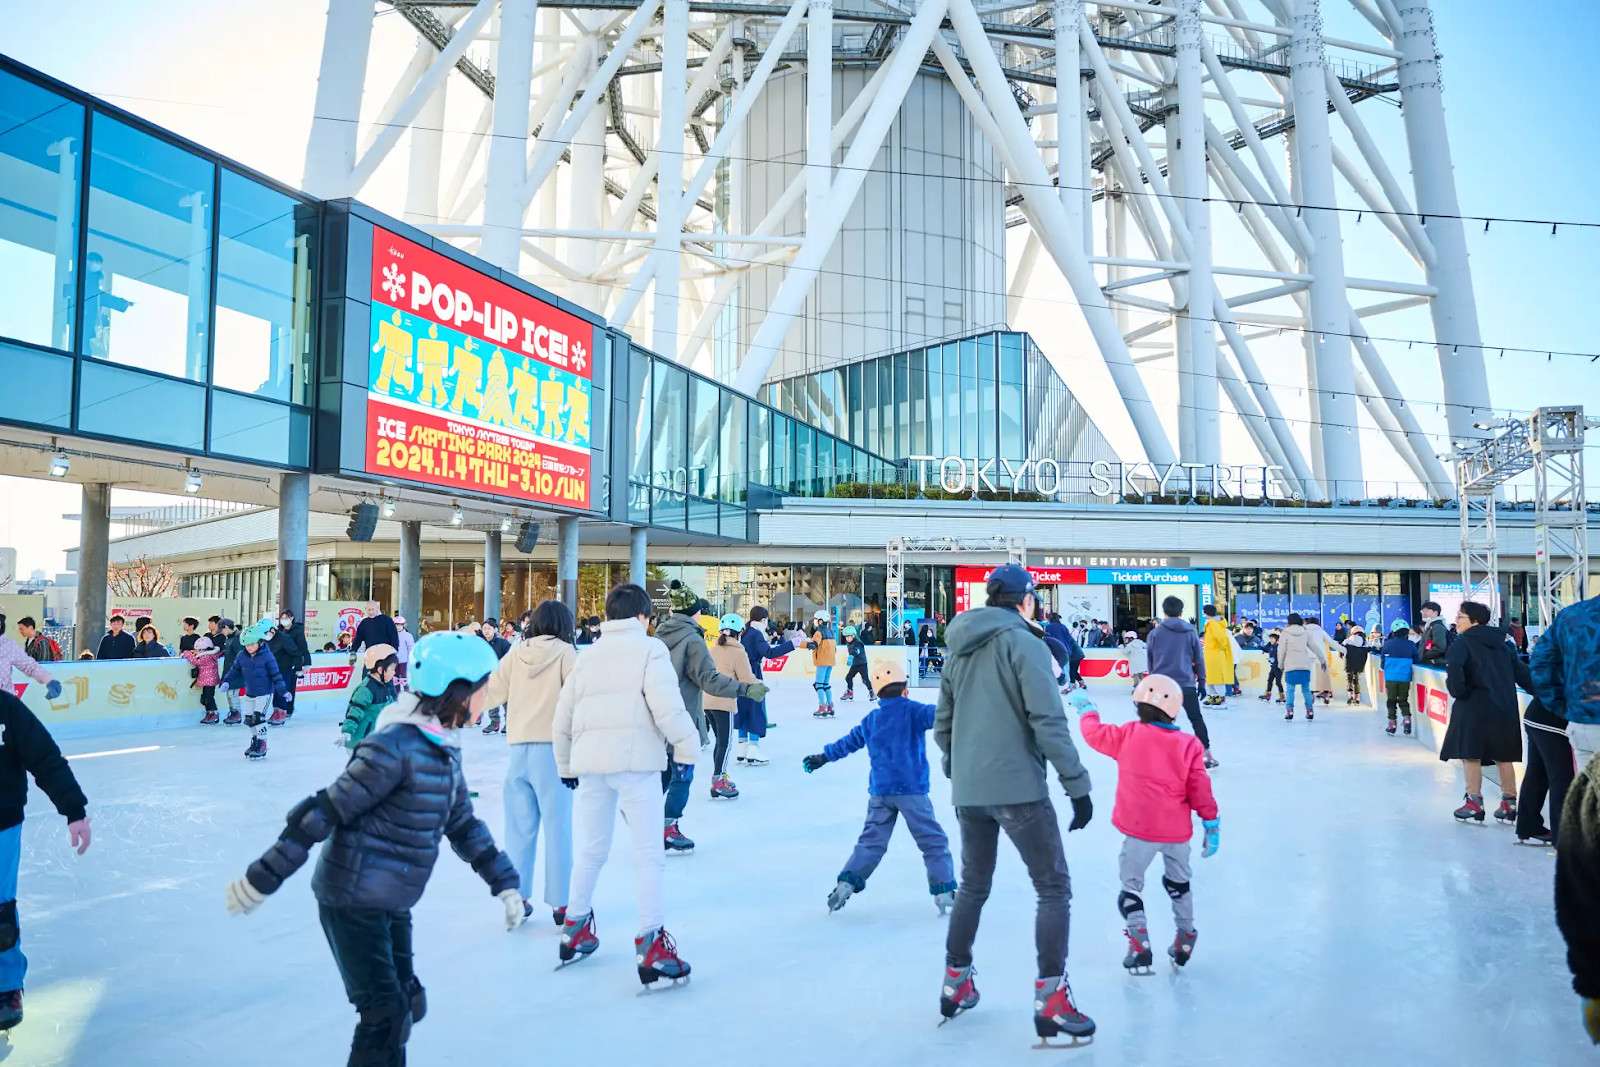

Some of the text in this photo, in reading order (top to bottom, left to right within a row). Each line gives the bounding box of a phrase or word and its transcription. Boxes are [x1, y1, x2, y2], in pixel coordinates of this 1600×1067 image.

[411, 270, 568, 368] POP-UP ICE!
[377, 416, 541, 470] ICE SKATING PARK 2024
[447, 421, 475, 437] TOKYO
[475, 429, 510, 446] SKYTREE
[376, 438, 467, 480] 2024.1.4
[554, 476, 585, 502] SUN
[908, 455, 1061, 495] TOKYO
[1031, 570, 1062, 582] Ticket
[1044, 556, 1168, 567] MAIN ENTRANCE
[1112, 571, 1190, 583] Ticket Purchase
